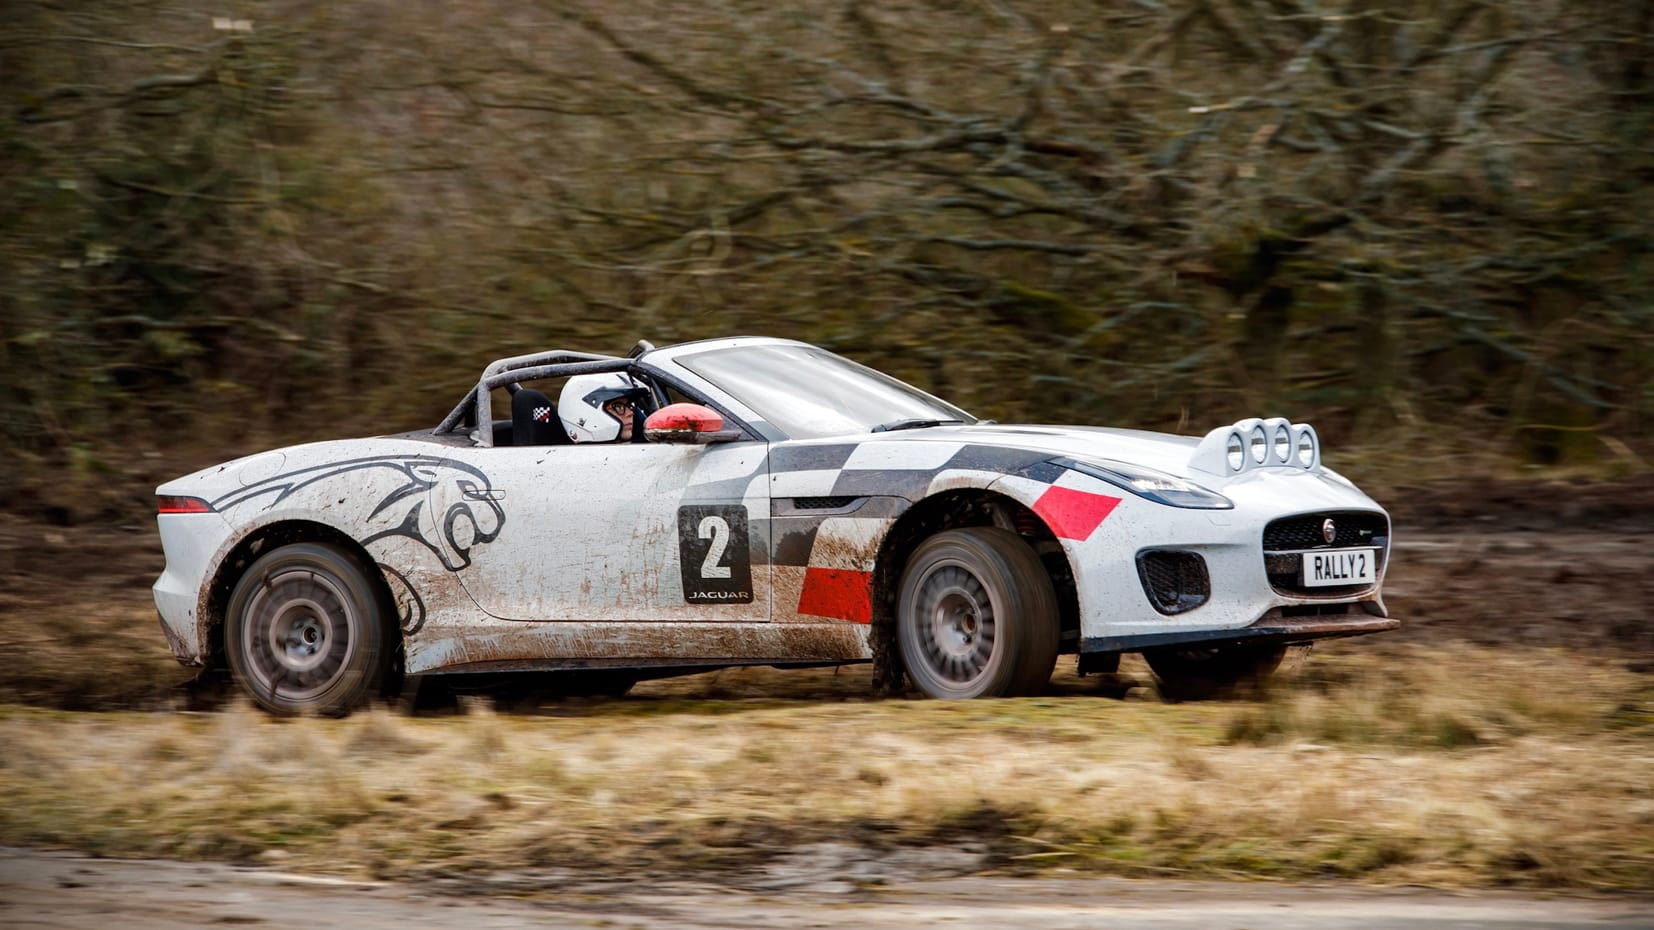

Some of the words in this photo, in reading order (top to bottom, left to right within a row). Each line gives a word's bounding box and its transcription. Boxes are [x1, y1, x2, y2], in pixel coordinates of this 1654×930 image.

[698, 515, 731, 578] 2
[1314, 554, 1355, 580] RALLY
[1359, 554, 1366, 577] 2
[688, 591, 749, 599] JAGUAR
